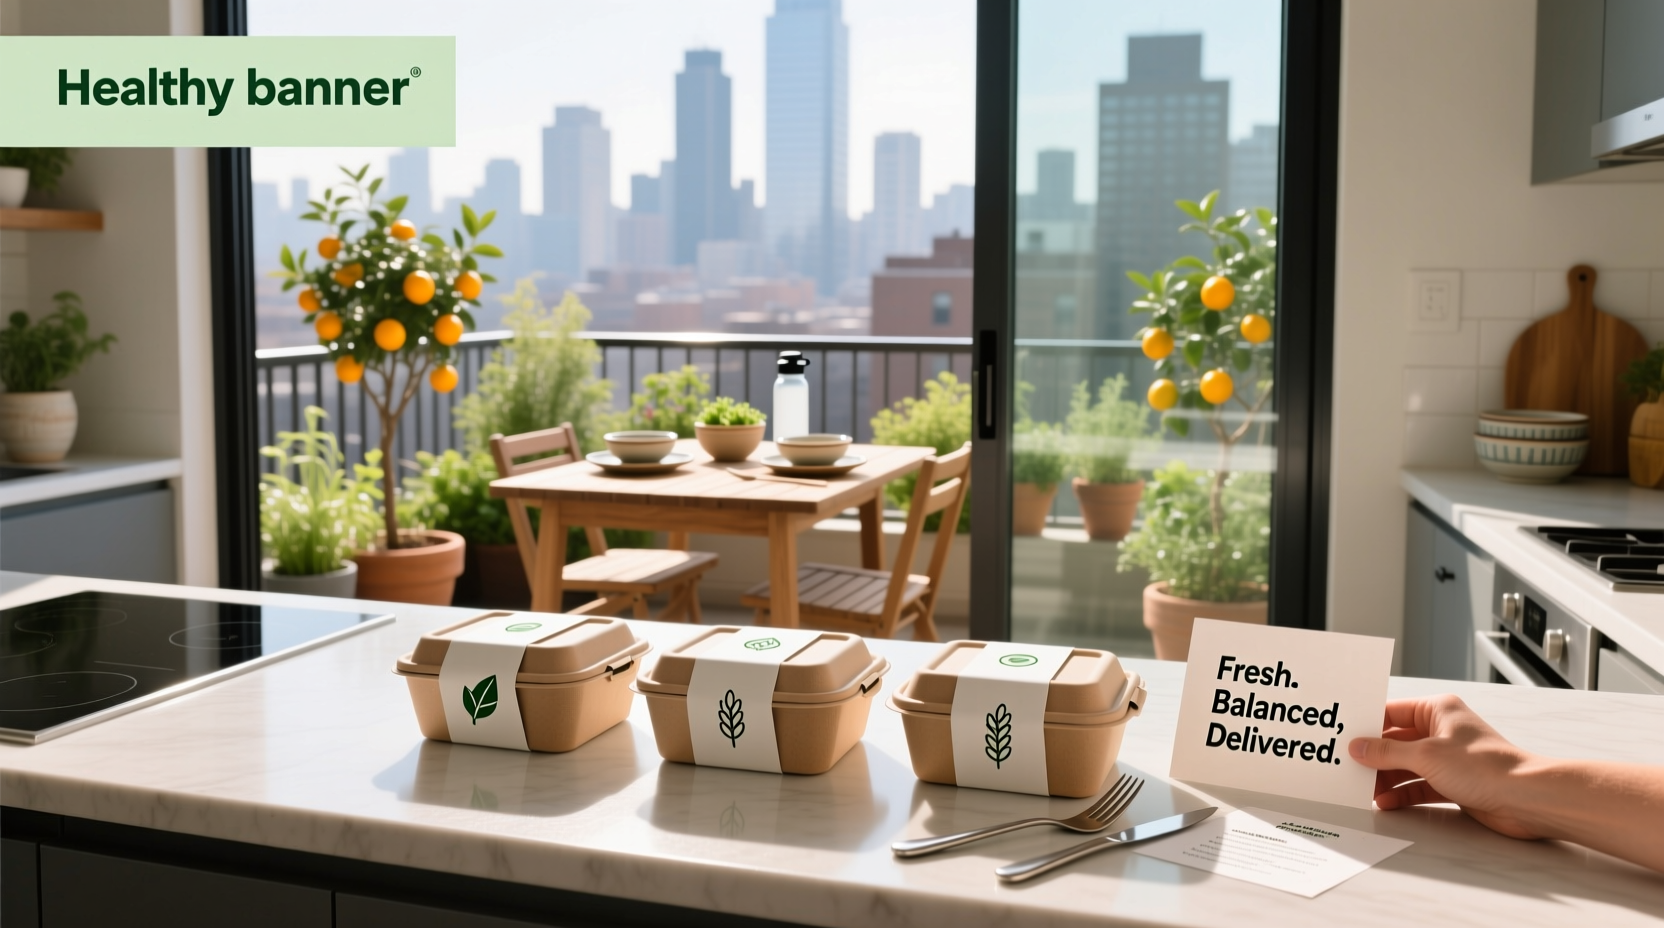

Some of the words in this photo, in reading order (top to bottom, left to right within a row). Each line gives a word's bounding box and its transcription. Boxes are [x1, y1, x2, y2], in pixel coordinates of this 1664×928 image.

[1216, 655, 1299, 689] Fresh.
[1211, 688, 1344, 735] Balanced,
[1205, 721, 1341, 766] Delivered.
